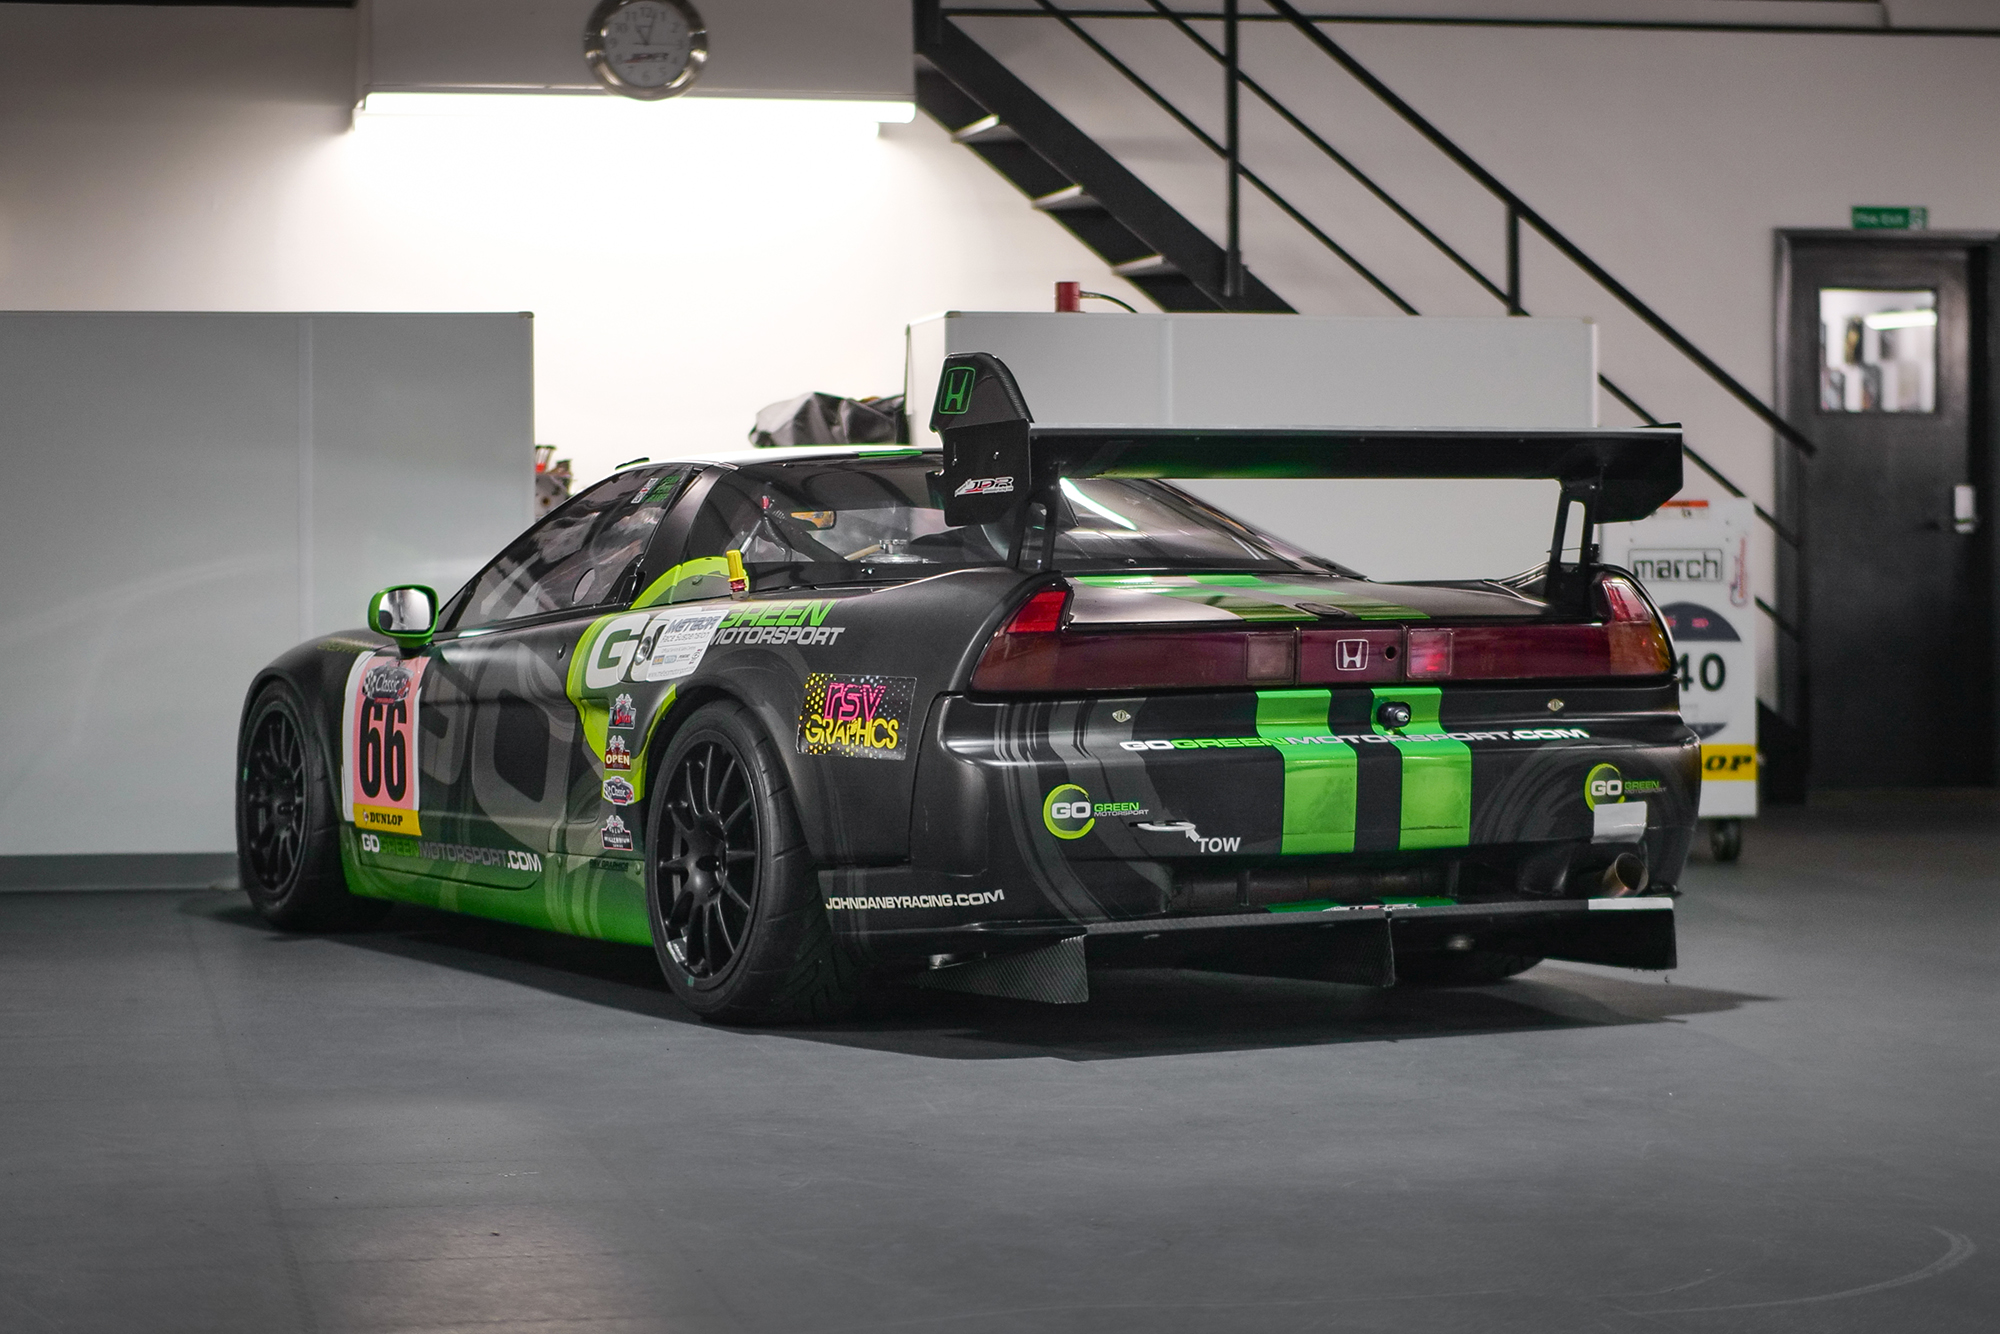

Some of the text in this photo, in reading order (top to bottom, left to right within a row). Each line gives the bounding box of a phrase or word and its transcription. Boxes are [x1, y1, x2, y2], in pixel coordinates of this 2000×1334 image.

[1633, 551, 1719, 578] march
[717, 600, 837, 628] GREEN
[805, 713, 899, 750] GRAPHICS
[1119, 728, 1590, 751] GOGREENMOTORSPORT.COM
[359, 696, 407, 802] 66
[605, 754, 630, 765] OPEN
[1591, 779, 1622, 796] GO
[1624, 780, 1660, 790] GREEN
[1051, 801, 1091, 819] GO
[1094, 802, 1140, 812] GREEN
[1094, 809, 1149, 817] MOTORSPORT
[370, 811, 403, 826] DUNLOP
[1198, 837, 1241, 853] TOW
[825, 889, 1005, 910] JOHNDANBYRACING.COM
